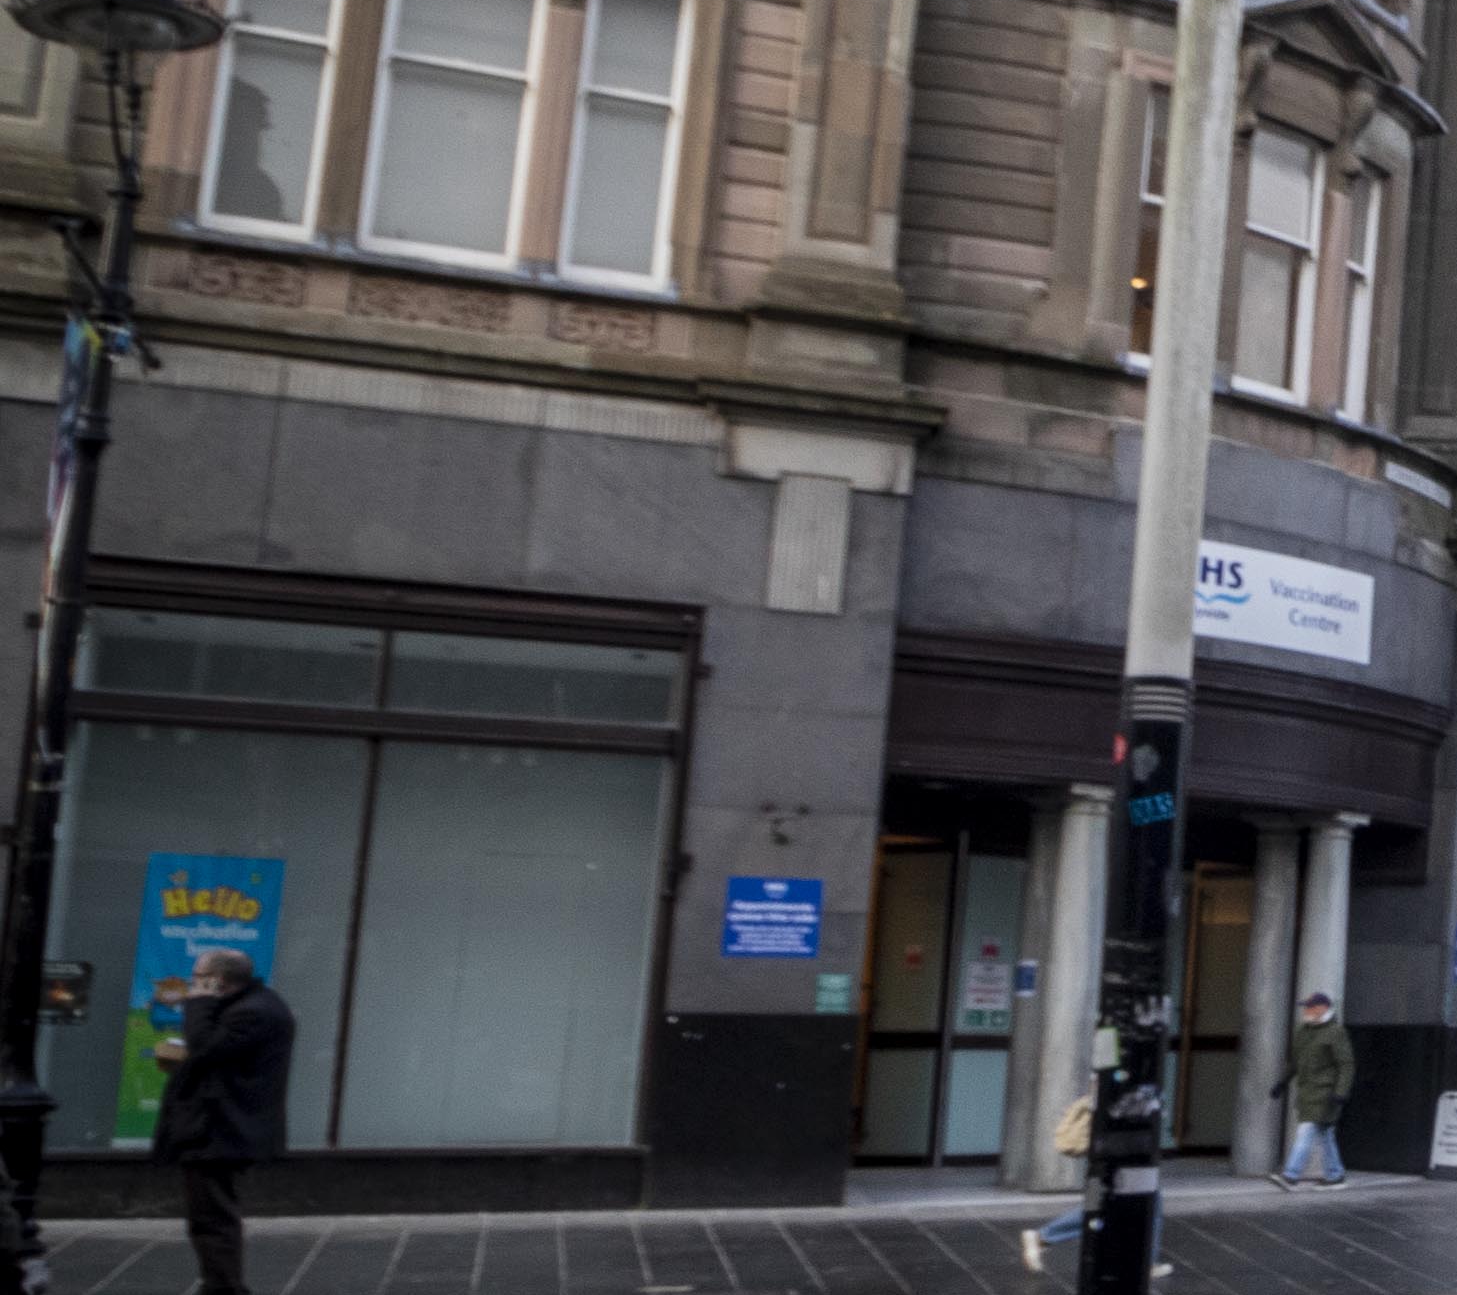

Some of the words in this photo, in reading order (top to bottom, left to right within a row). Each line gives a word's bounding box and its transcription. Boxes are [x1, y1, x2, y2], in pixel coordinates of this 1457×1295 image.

[1199, 556, 1243, 590] HS
[1269, 577, 1361, 614] Vaccination
[1287, 607, 1342, 636] Centre
[162, 885, 262, 923] Hello
